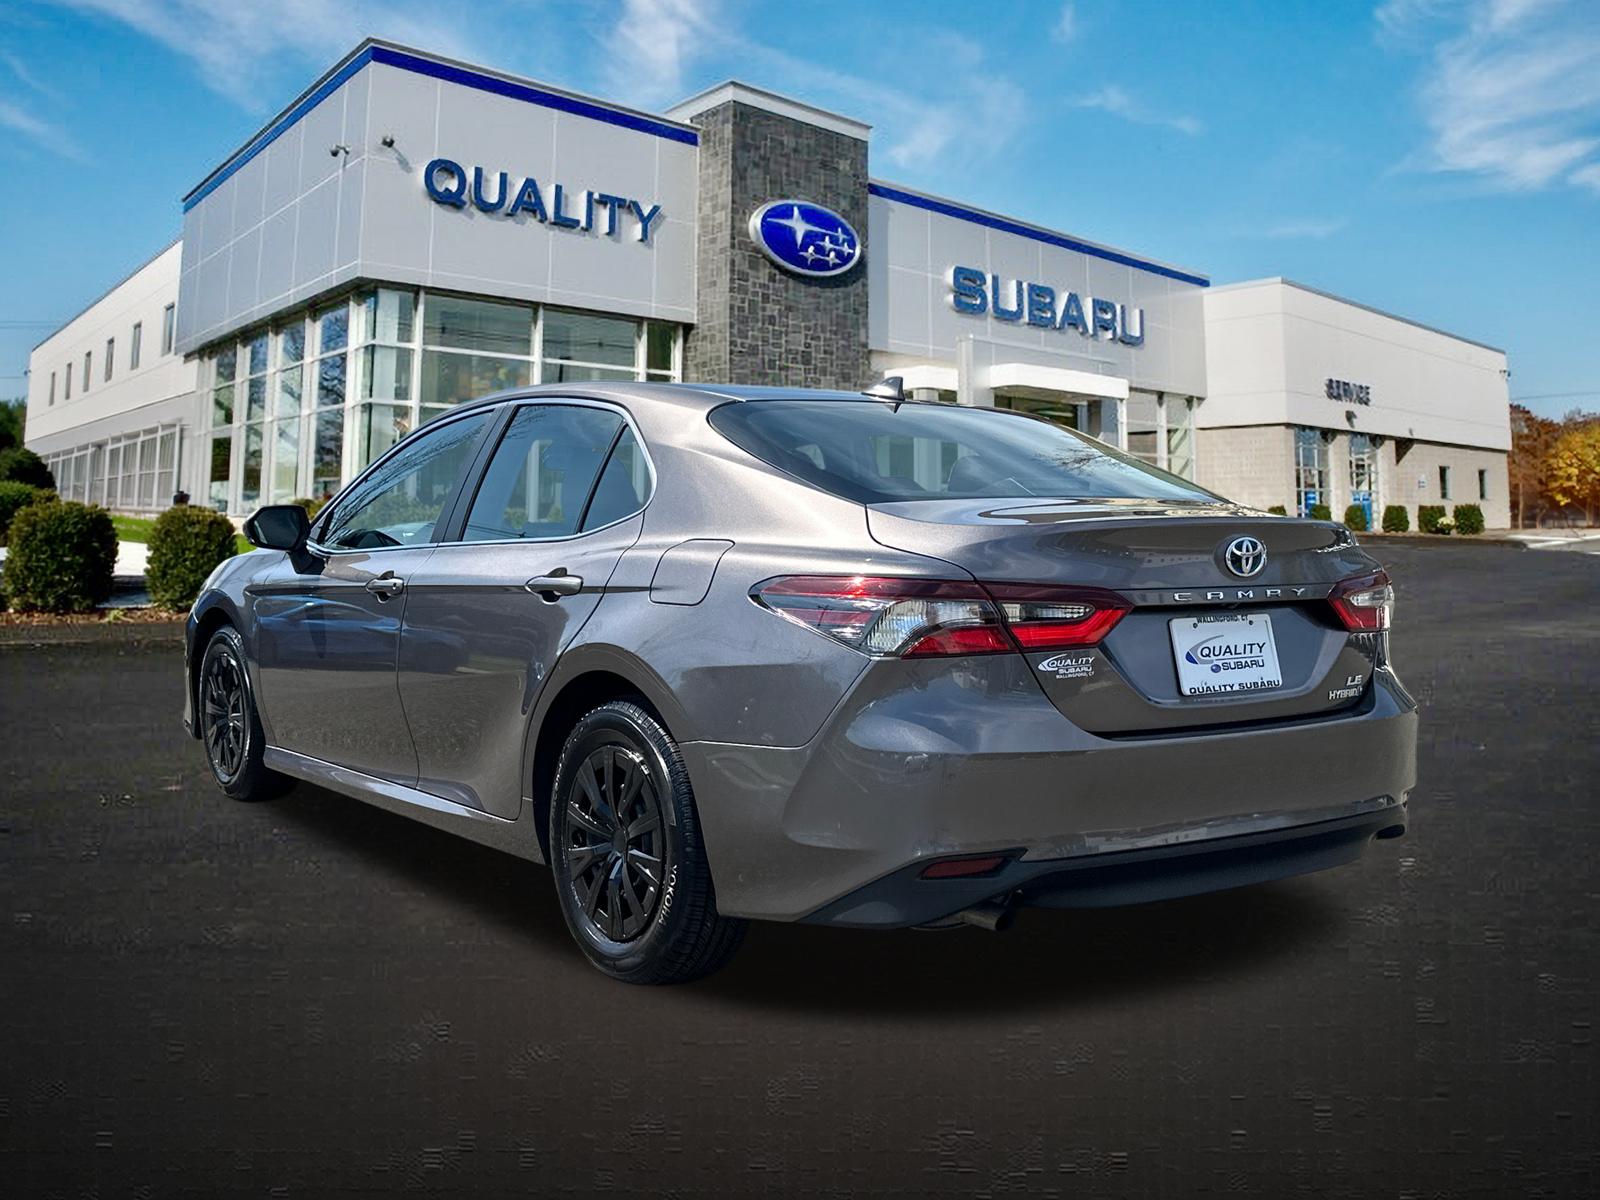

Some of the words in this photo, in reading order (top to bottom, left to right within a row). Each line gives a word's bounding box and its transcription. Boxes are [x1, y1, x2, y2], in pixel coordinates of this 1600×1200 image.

[423, 158, 662, 243] QUALITY
[948, 265, 1145, 347] SUBARU
[1325, 378, 1371, 406] SERVICE
[1173, 587, 1306, 601] CAMRY
[1200, 642, 1266, 658] QUALITY
[1048, 657, 1095, 667] QUALITY
[1222, 659, 1265, 671] SUBARU
[1058, 666, 1092, 674] SUBARU
[1189, 683, 1235, 695] QUALITY
[1238, 680, 1281, 690] SUBARU
[1347, 675, 1362, 686] LE
[1329, 686, 1362, 700] HYBRID
